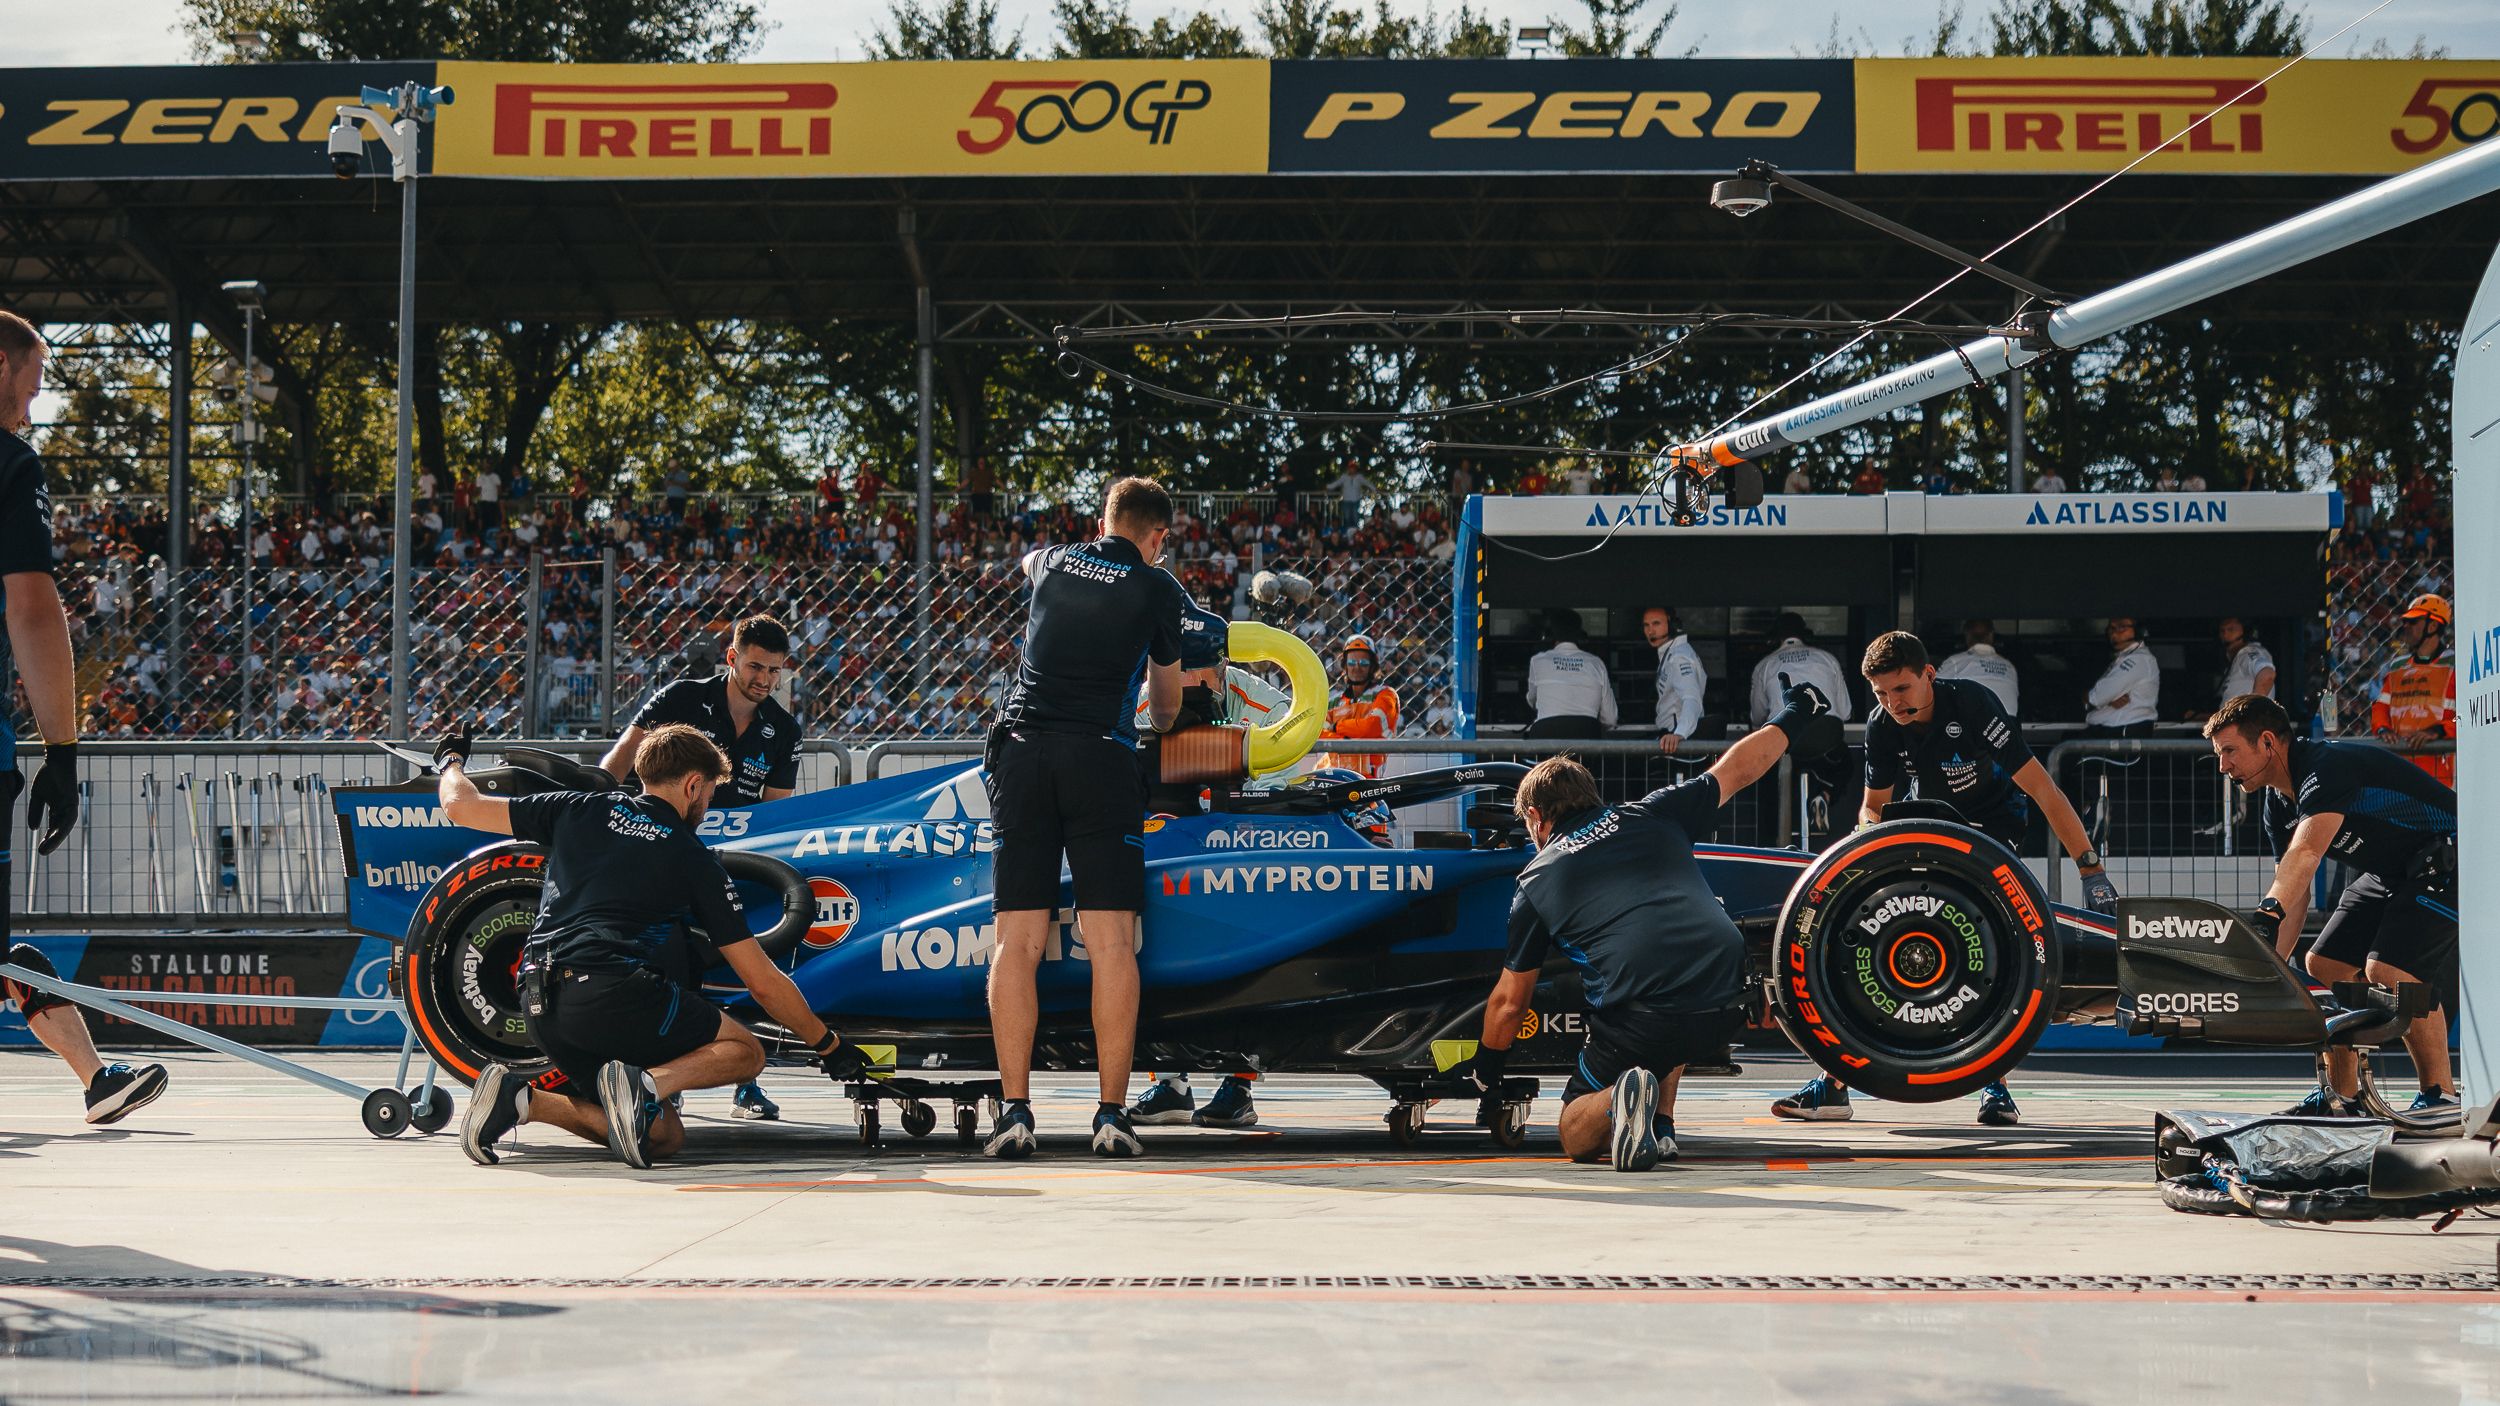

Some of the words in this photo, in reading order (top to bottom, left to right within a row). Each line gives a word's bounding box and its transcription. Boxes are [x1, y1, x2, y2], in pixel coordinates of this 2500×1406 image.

[493, 83, 838, 156] PIRELLI
[1303, 92, 1406, 140] P
[1429, 91, 1821, 140] ZERO
[1915, 78, 2268, 153] PIRELLI
[1614, 503, 1786, 527] ATLSSIAN
[2054, 500, 2227, 525] ATLASSIAN
[1063, 564, 1115, 584] RACING
[1064, 555, 1128, 578] WILLIAMS
[1068, 549, 1132, 572] ATLASSIAN
[1360, 785, 1401, 799] KEEPER
[356, 806, 462, 828] KOMA
[607, 820, 656, 841] RACING
[695, 811, 752, 837] 23
[792, 821, 994, 858] ATLASS
[446, 855, 546, 897] ZERO
[1203, 865, 1434, 894] MYPROTEIN
[816, 901, 854, 922] ulf
[1992, 864, 2044, 933] PIRELLI
[1859, 895, 1945, 936] betway
[2128, 914, 2234, 943] betway
[1941, 904, 1983, 972] SCORES
[131, 954, 269, 975] STALLONE
[463, 944, 497, 1025] betway
[1856, 946, 1898, 1015] SCORES
[216, 976, 295, 1026] KING
[1790, 943, 1841, 1048] ZERO
[1894, 984, 1980, 1024] betway
[2137, 992, 2240, 1014] SCORES
